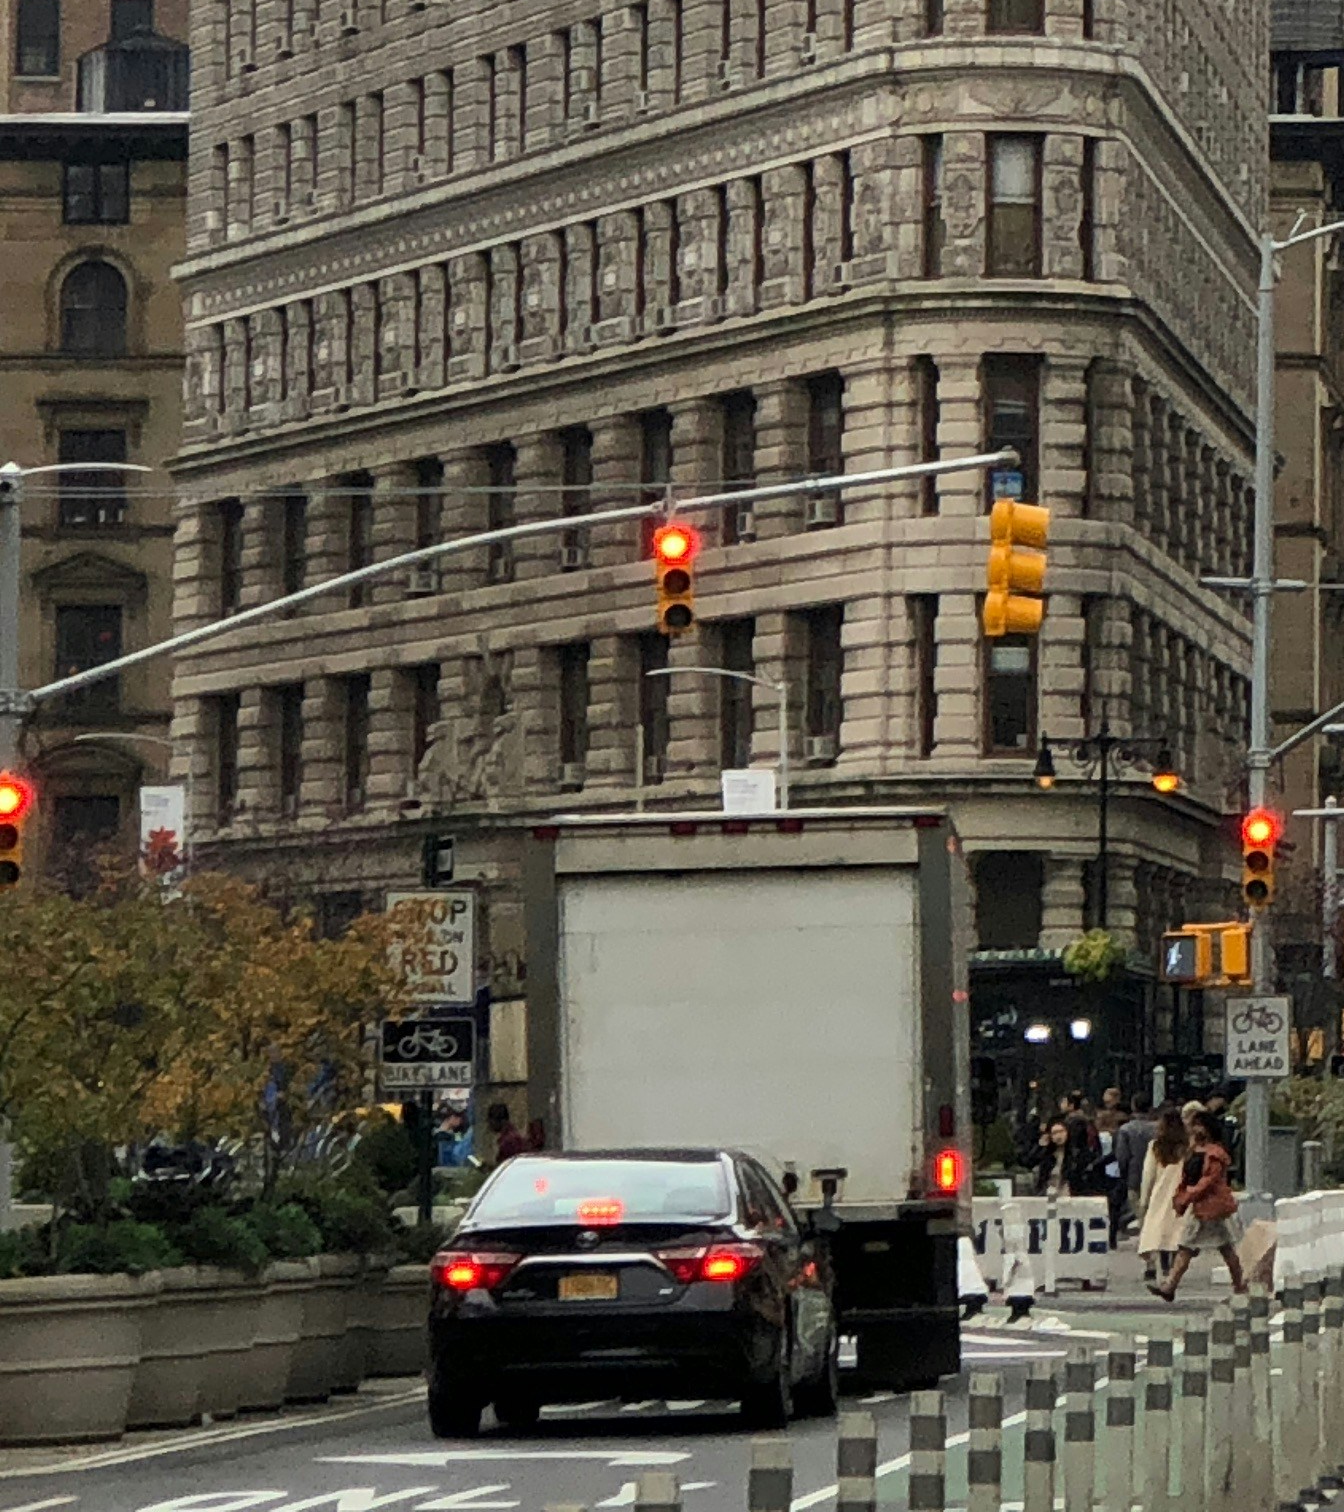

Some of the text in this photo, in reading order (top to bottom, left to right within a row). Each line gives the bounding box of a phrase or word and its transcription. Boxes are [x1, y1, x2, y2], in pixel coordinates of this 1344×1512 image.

[402, 950, 459, 976] RED
[1238, 1040, 1278, 1054] LANE
[1234, 1056, 1285, 1071] AHEAD
[429, 1065, 469, 1083] LANE
